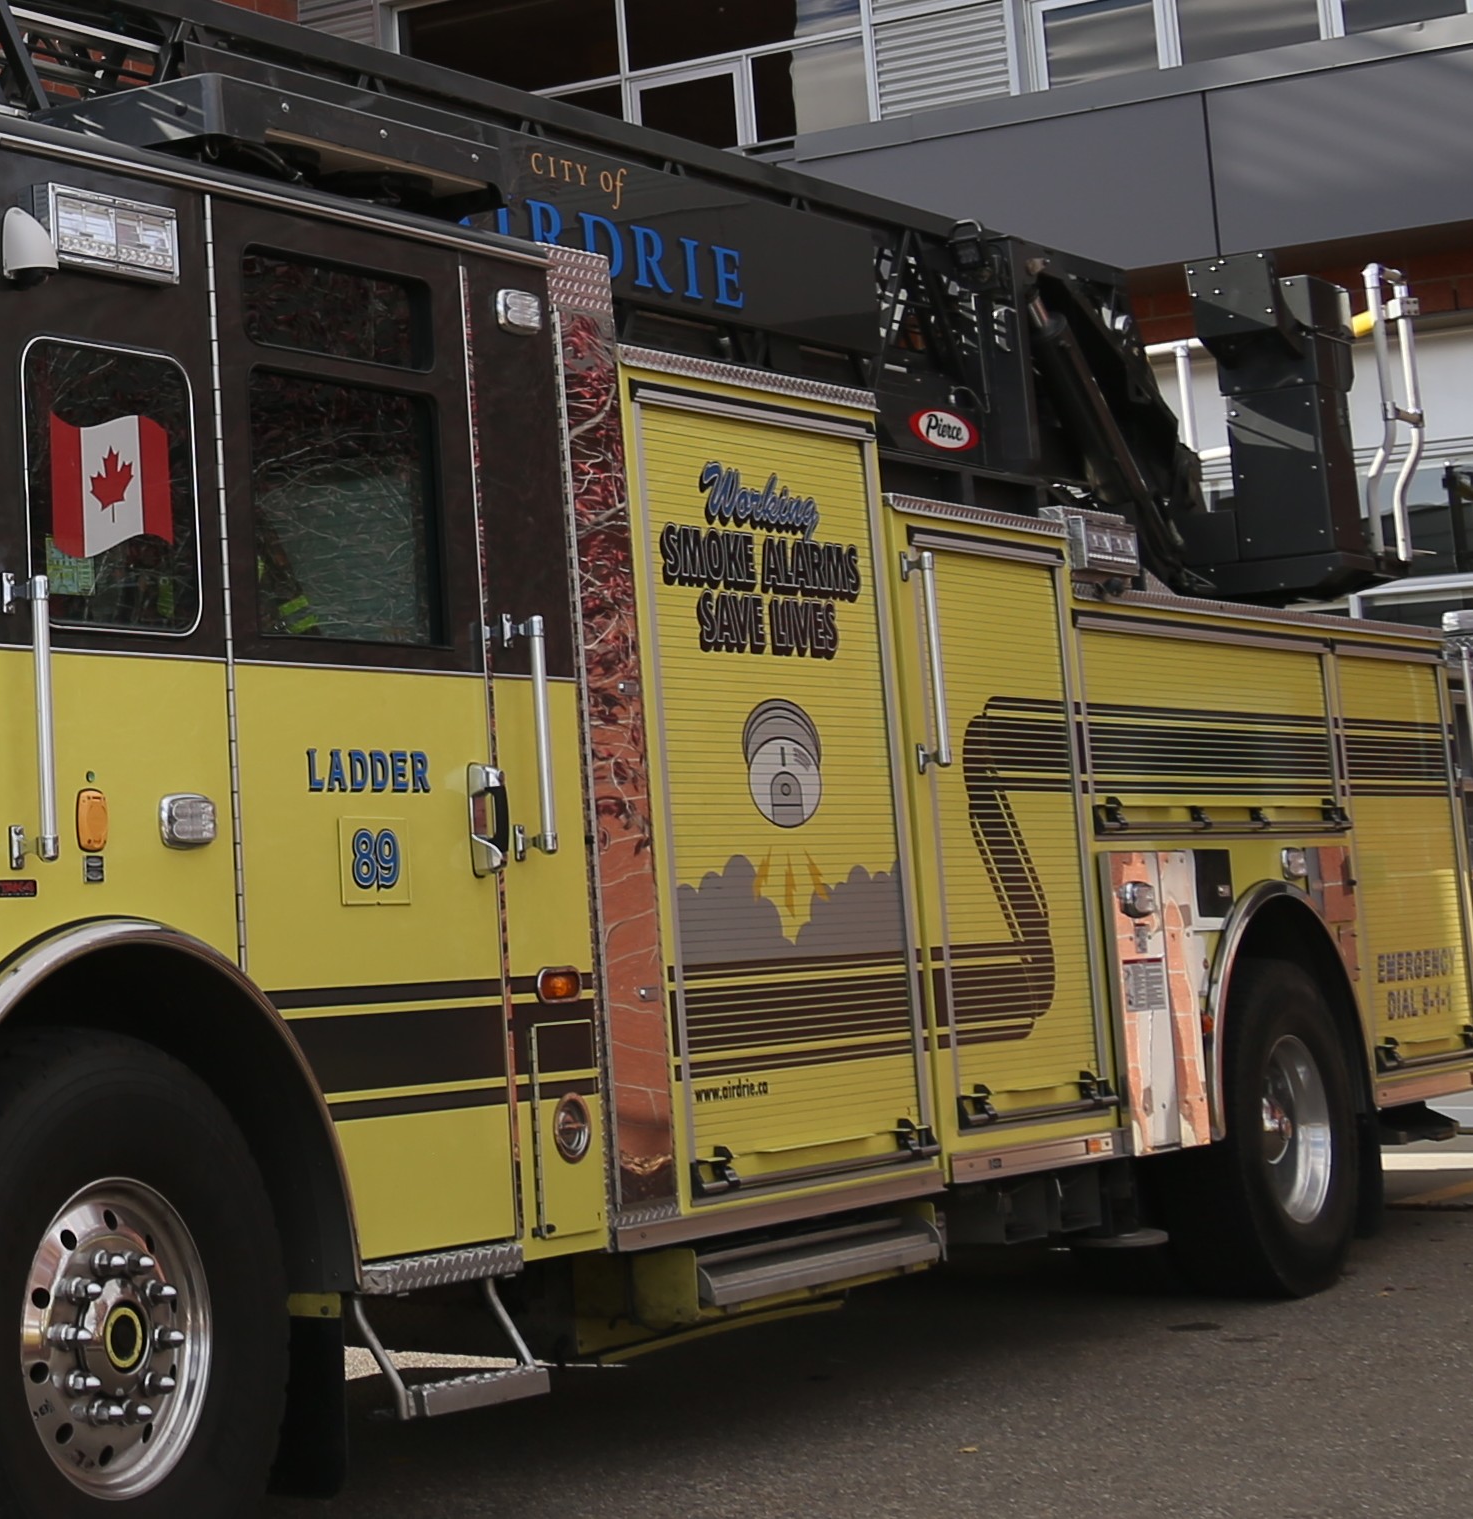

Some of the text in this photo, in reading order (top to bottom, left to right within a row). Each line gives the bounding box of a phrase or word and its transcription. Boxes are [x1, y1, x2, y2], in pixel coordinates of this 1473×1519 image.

[530, 152, 627, 210] CITY of
[458, 196, 745, 309] RDRIE
[925, 413, 964, 441] Pierce
[699, 460, 820, 542] Working
[660, 521, 861, 604] SMOKE ALARMS
[697, 588, 840, 661] SAVE LIVES
[306, 748, 431, 793] LADDER
[352, 828, 400, 892] 89
[1377, 948, 1455, 983] EMERGENCY
[1388, 985, 1452, 1020] DIAL 9-1-1
[694, 1078, 769, 1102] www.airdrie.ca
